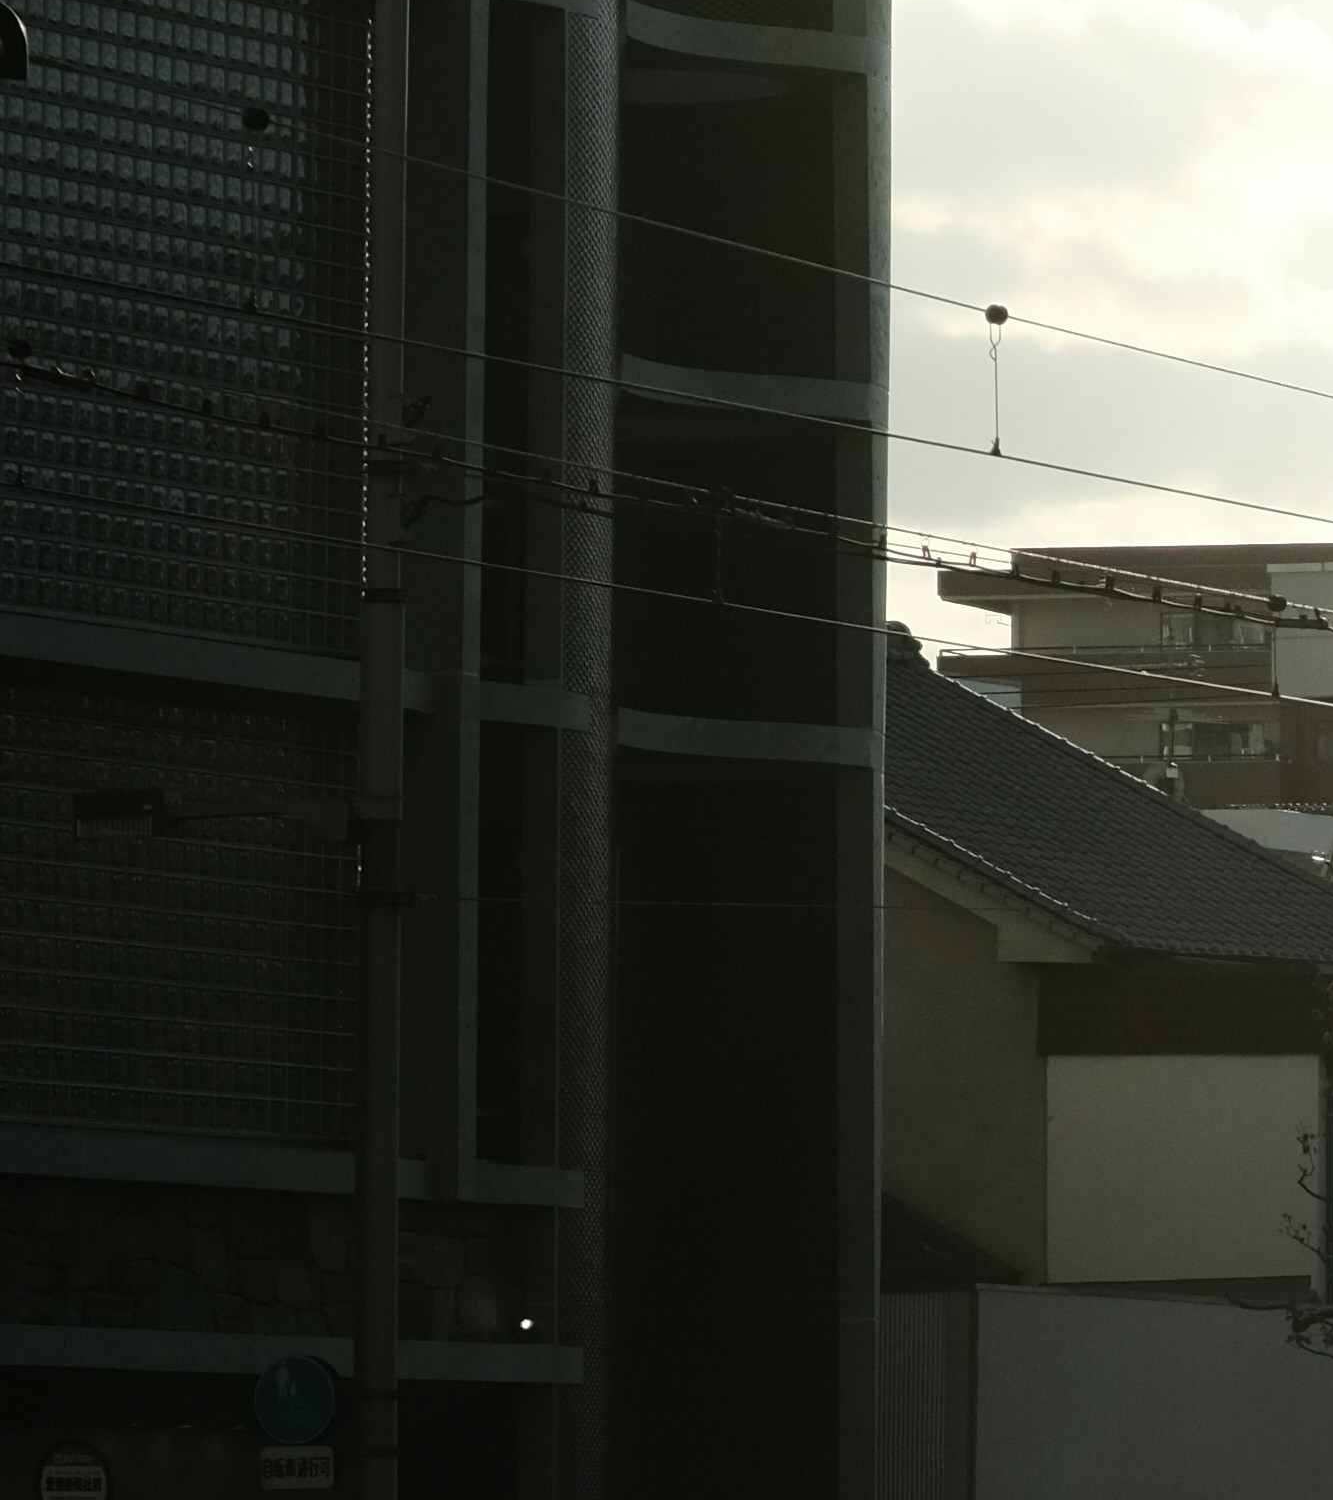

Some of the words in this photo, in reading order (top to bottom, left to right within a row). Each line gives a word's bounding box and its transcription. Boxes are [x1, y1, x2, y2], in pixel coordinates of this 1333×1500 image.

[262, 1457, 331, 1479] 自転車通行可
[46, 1477, 102, 1492] 愛媛新聞社前
